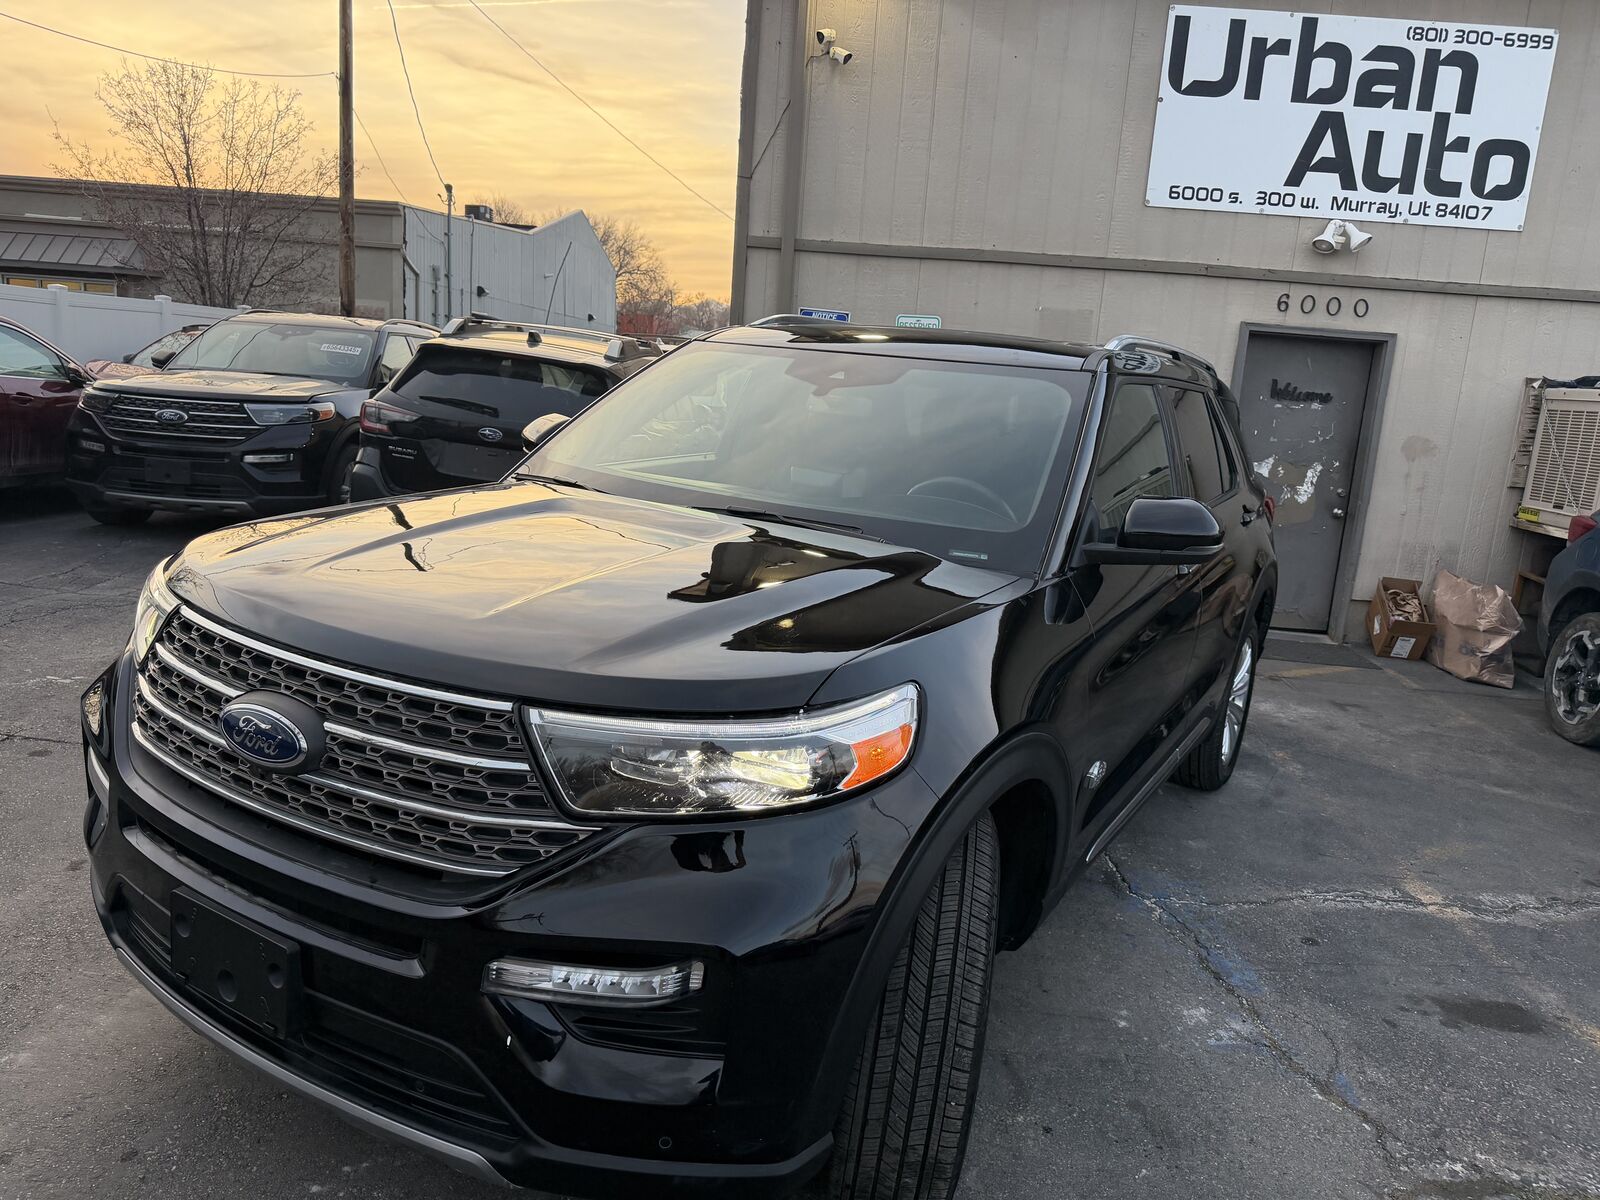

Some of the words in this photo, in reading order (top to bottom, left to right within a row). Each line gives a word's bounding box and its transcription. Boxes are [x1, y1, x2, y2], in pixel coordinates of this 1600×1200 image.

[1406, 25, 1449, 43] (801)
[1453, 29, 1554, 50] 300-6999
[1168, 14, 1479, 115] Urban
[1283, 110, 1531, 202] Auto
[1168, 185, 1224, 203] 6000
[1255, 190, 1296, 208] 300
[1330, 196, 1403, 219] Murray,
[1408, 200, 1431, 217] Ut
[1435, 203, 1494, 221] 84107
[812, 311, 838, 321] NOTICE
[1276, 293, 1371, 318] 6000
[387, 445, 418, 455] SUBARU
[232, 715, 282, 756] Ford
